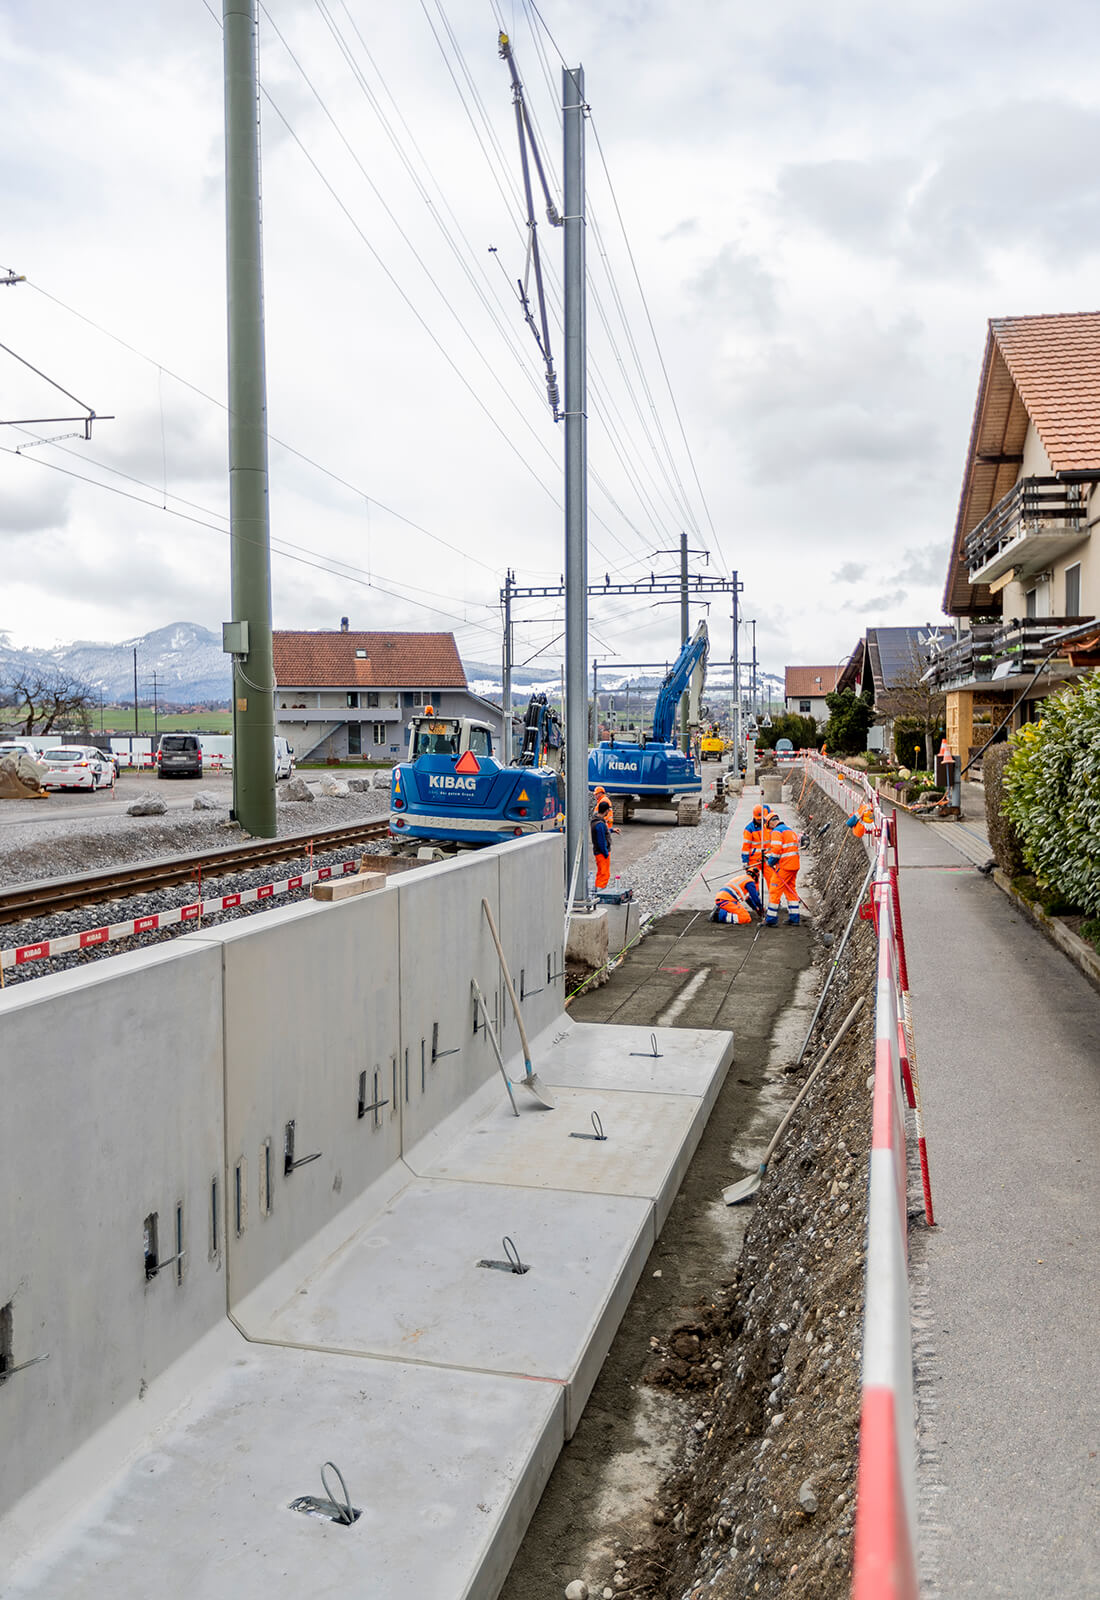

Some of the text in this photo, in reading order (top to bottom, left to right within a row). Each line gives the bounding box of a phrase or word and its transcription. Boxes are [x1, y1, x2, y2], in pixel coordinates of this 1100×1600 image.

[608, 761, 637, 771] KIBAG
[429, 775, 476, 790] KIBAG
[140, 920, 153, 928] KIBAG
[86, 932, 102, 942] KIBAG
[23, 947, 42, 958] KIBAG
